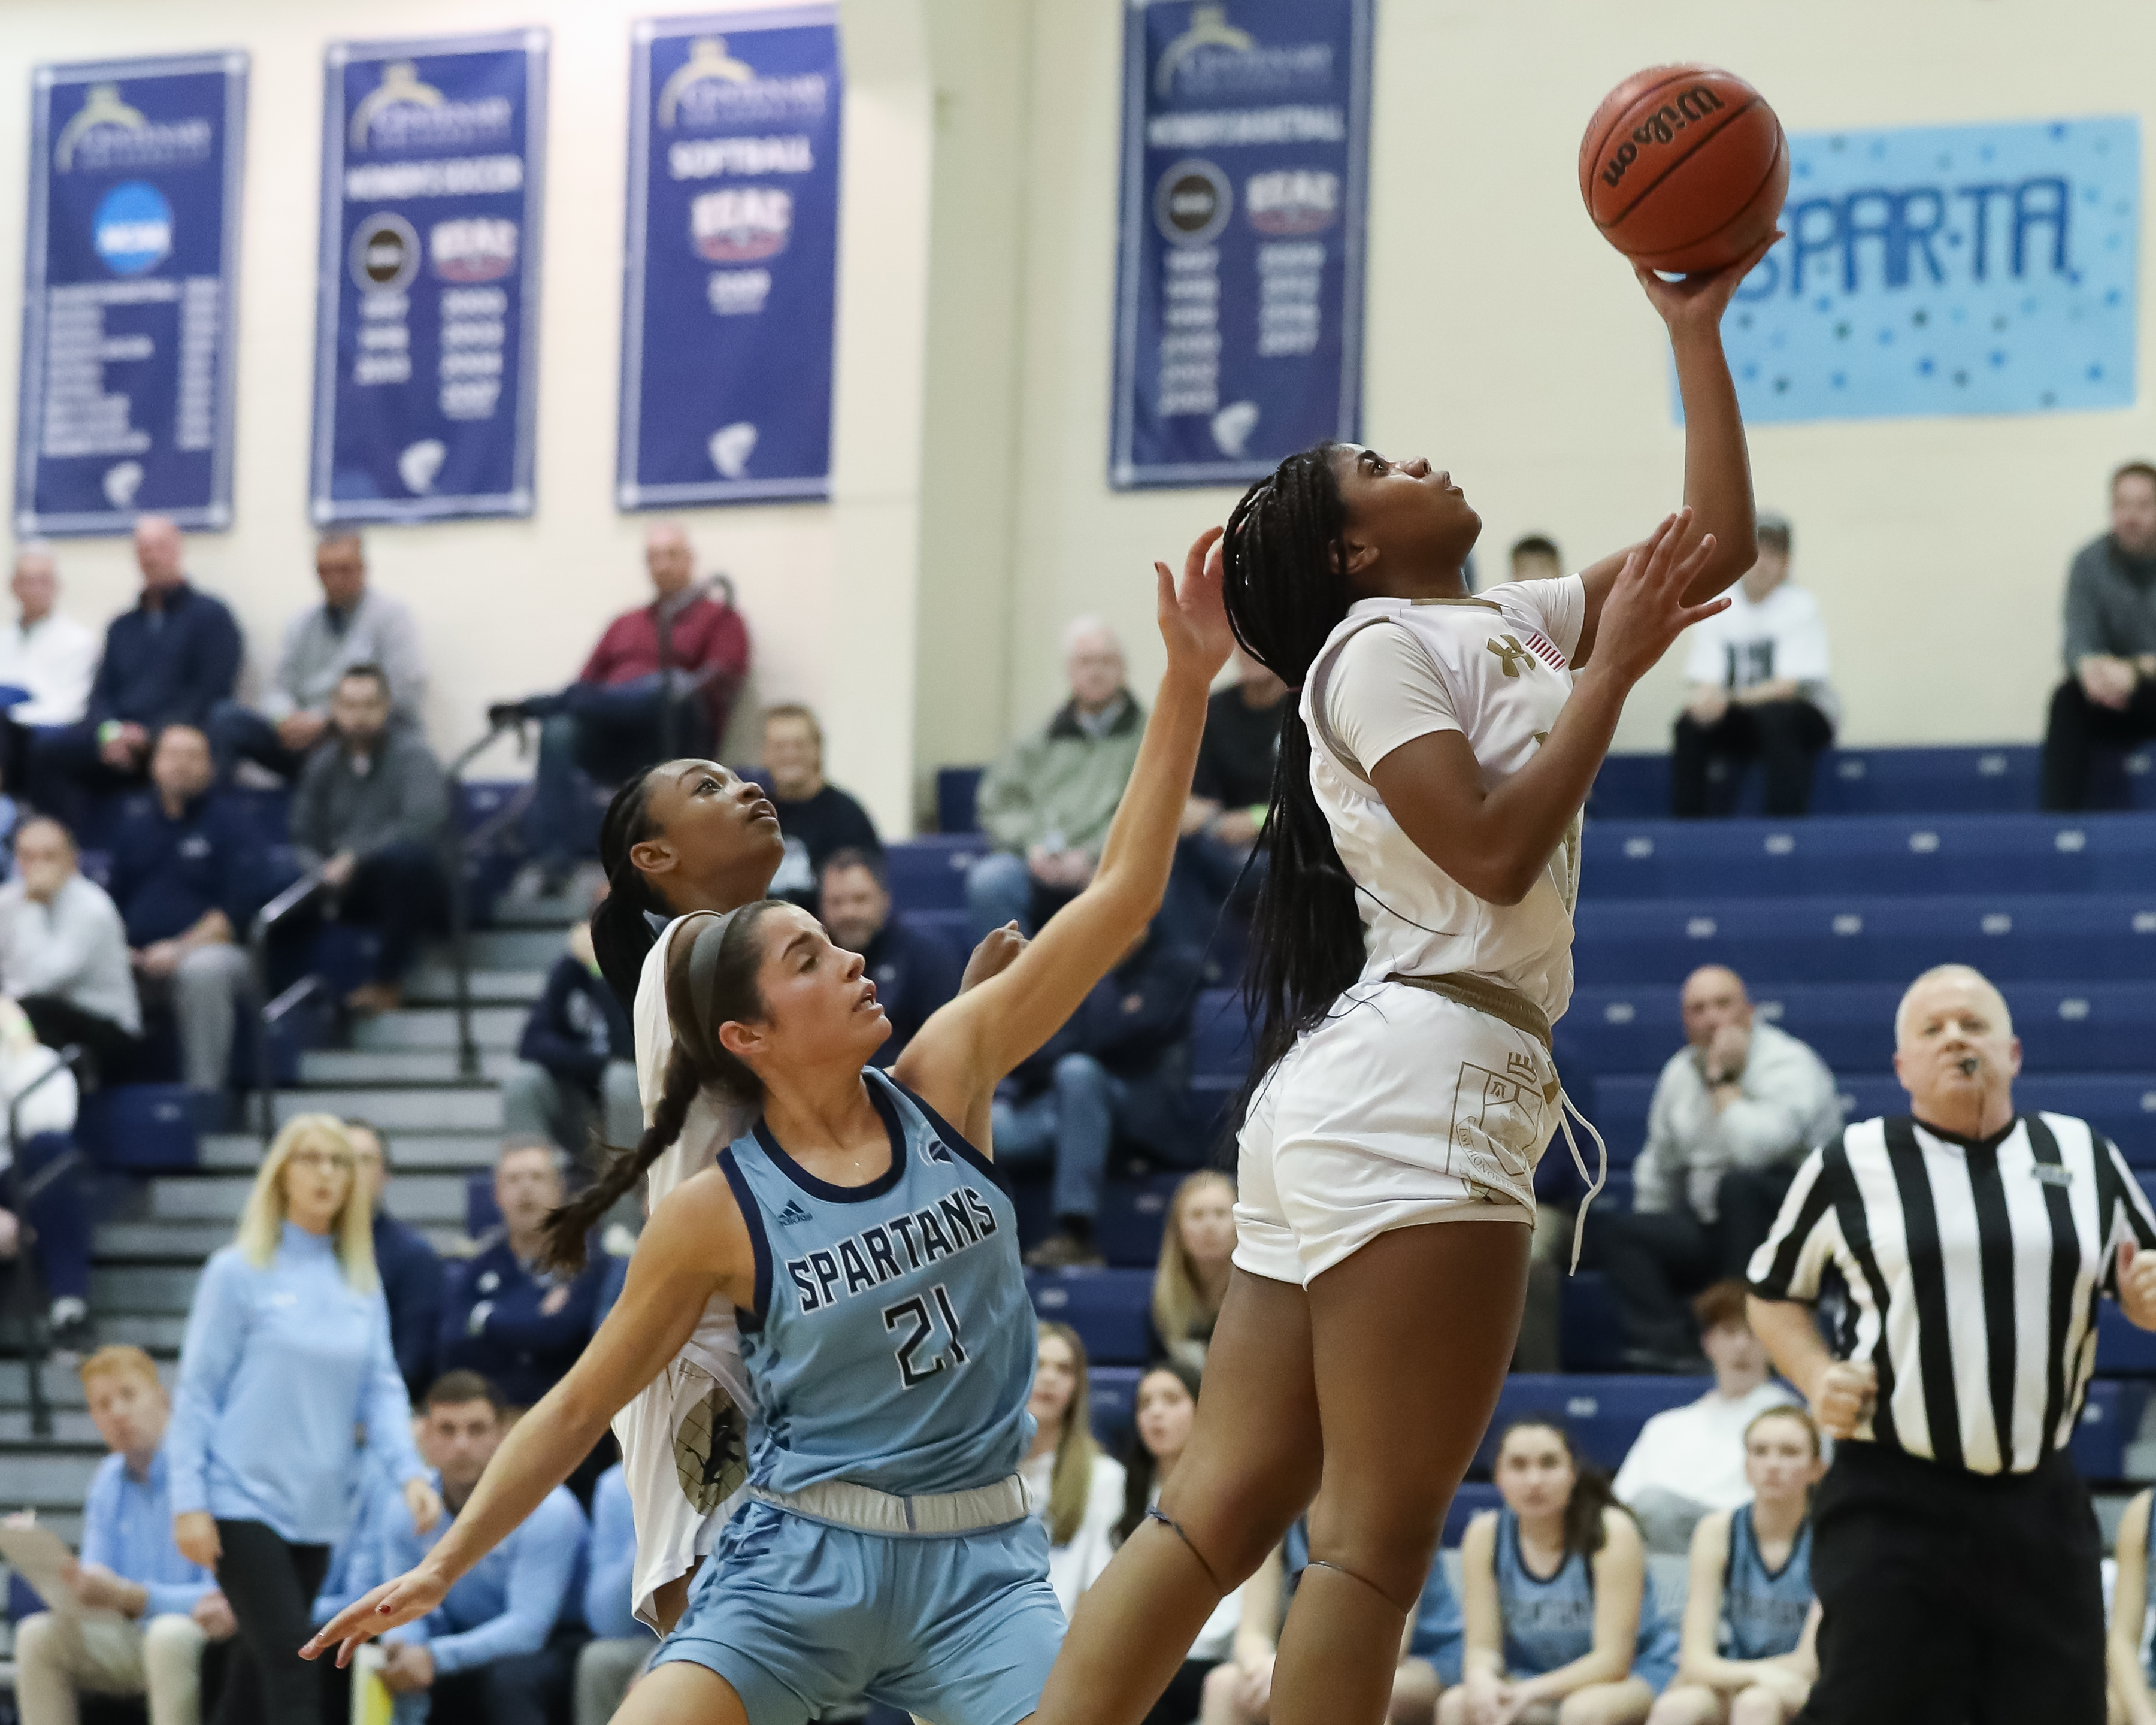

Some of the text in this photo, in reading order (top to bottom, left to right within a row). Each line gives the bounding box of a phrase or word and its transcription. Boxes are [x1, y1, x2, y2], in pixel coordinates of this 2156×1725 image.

[1602, 85, 1725, 187] Wilson
[785, 1186, 998, 1315] SPARTANS
[881, 1282, 971, 1390] 21
